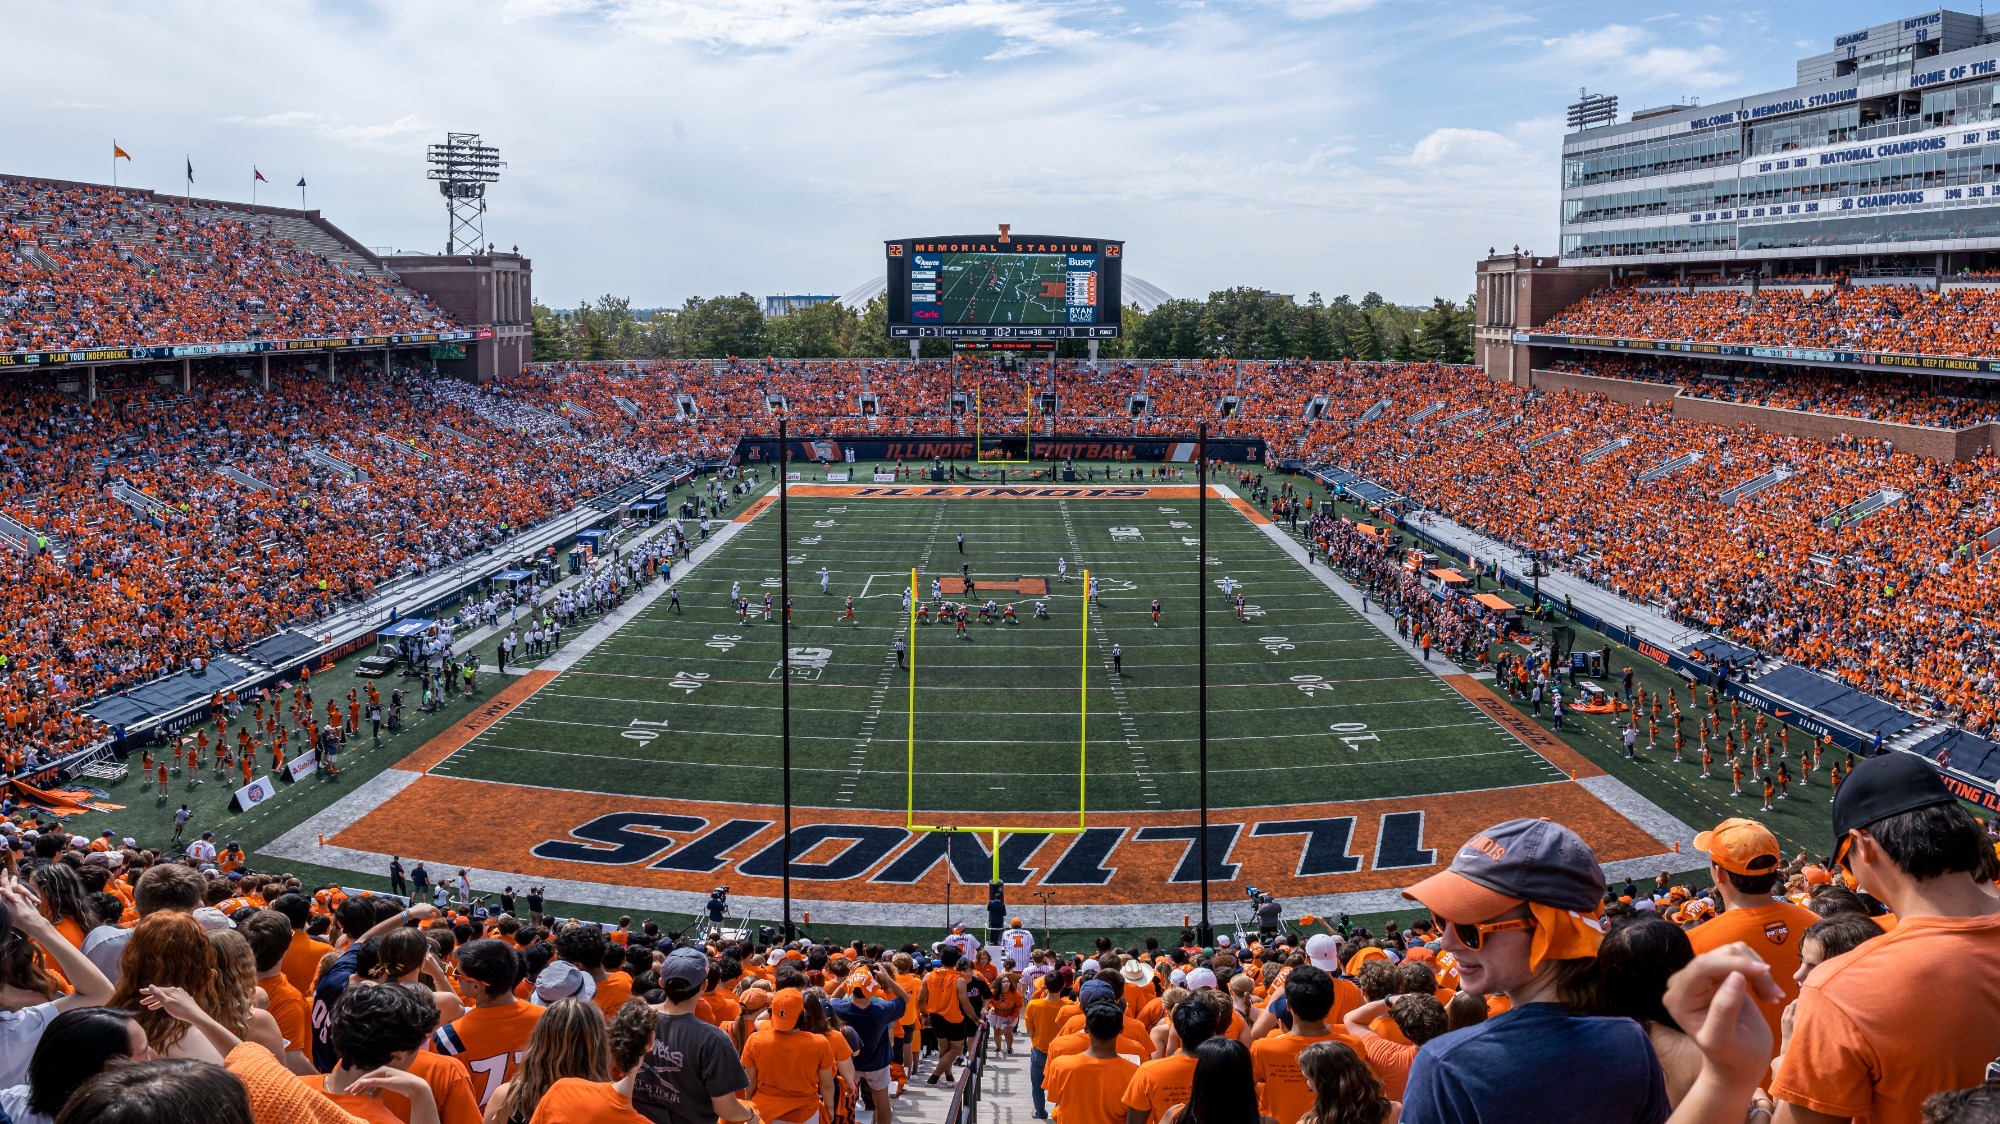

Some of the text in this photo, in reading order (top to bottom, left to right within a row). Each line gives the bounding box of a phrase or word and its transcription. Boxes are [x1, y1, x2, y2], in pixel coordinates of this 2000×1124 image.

[1905, 12, 1941, 31] BUTKUS
[1836, 31, 1869, 47] GRANGE
[1915, 28, 1928, 43] 50
[1847, 45, 1856, 59] 77
[1910, 59, 1997, 88] HOME OF THE
[1690, 87, 1857, 130] WELCOME TO MEMORIAL STADIUM
[1820, 147, 1874, 165] NATIONAL
[1877, 136, 1946, 157] CHAMPIONS
[1962, 132, 1980, 145] 1927
[1857, 191, 1924, 209] CHAMPIONS
[890, 245, 903, 256] 22
[915, 244, 1092, 252] MEMORIAL STADIUM
[1106, 245, 1119, 256] 22
[1068, 257, 1095, 268] Busey
[50, 352, 69, 363] PLANT
[69, 351, 86, 363] YOUR
[86, 349, 130, 361] INDEPENDENCE.
[1880, 356, 1894, 365] KEEP
[1894, 357, 1901, 365] IT
[1901, 357, 1920, 367] LOCAL.
[1922, 358, 1936, 368] KEEP
[1938, 359, 1945, 368] IT
[1945, 359, 1980, 371] AMERICAN.
[886, 442, 1137, 460] ILLINOIS FOOTBALL
[851, 487, 1154, 499] ILLINOIS
[320, 641, 356, 666] FIGHTING
[1637, 641, 1670, 665] ILLINOIS
[529, 809, 1438, 887] ILLINOIS
